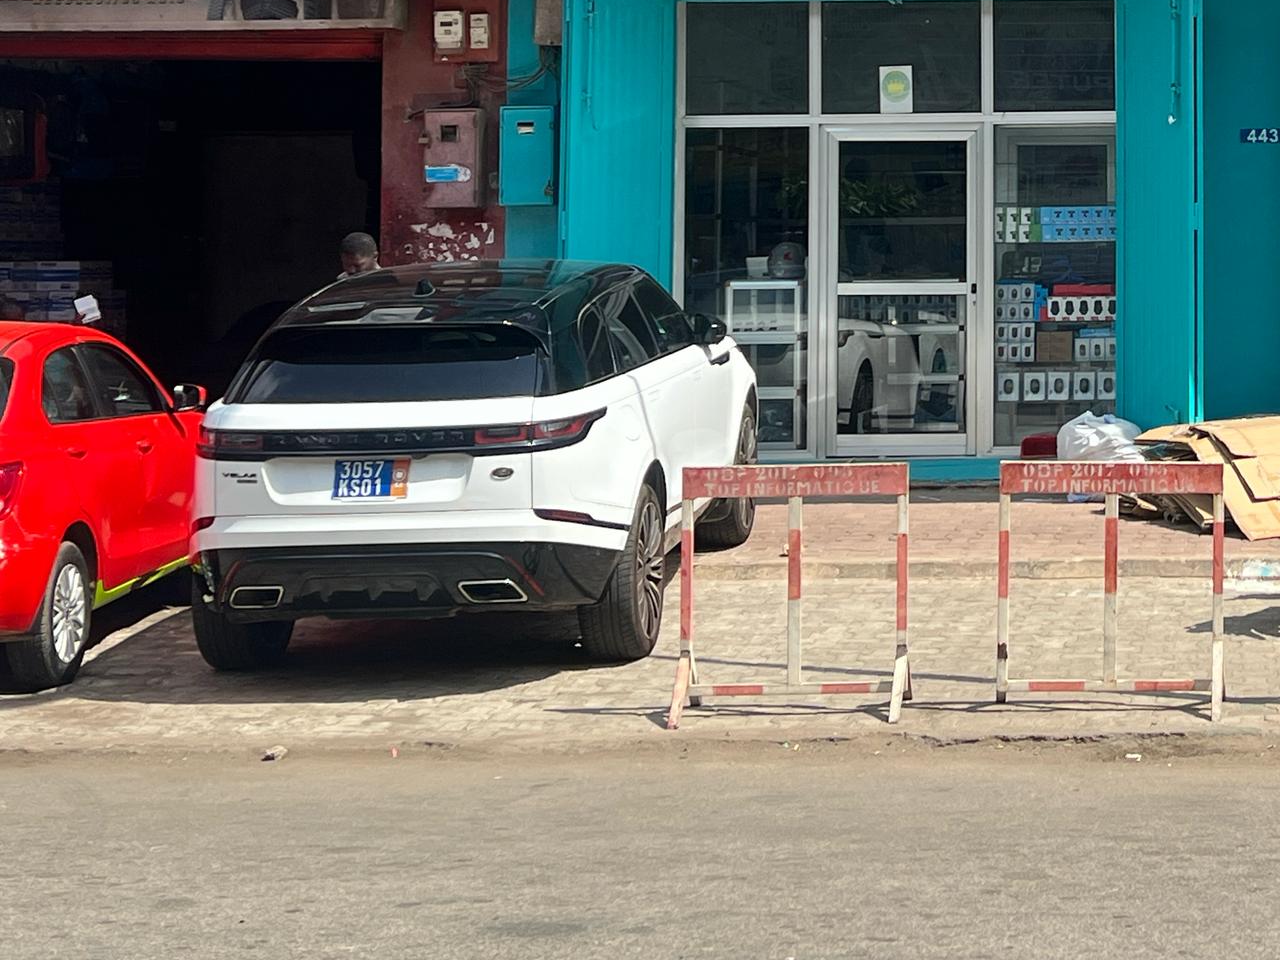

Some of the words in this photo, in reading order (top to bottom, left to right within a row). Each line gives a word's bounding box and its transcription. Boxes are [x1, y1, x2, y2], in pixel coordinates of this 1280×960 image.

[1247, 129, 1279, 143] 443
[341, 461, 384, 479] 3057
[747, 480, 880, 496] INFORMATIQUE
